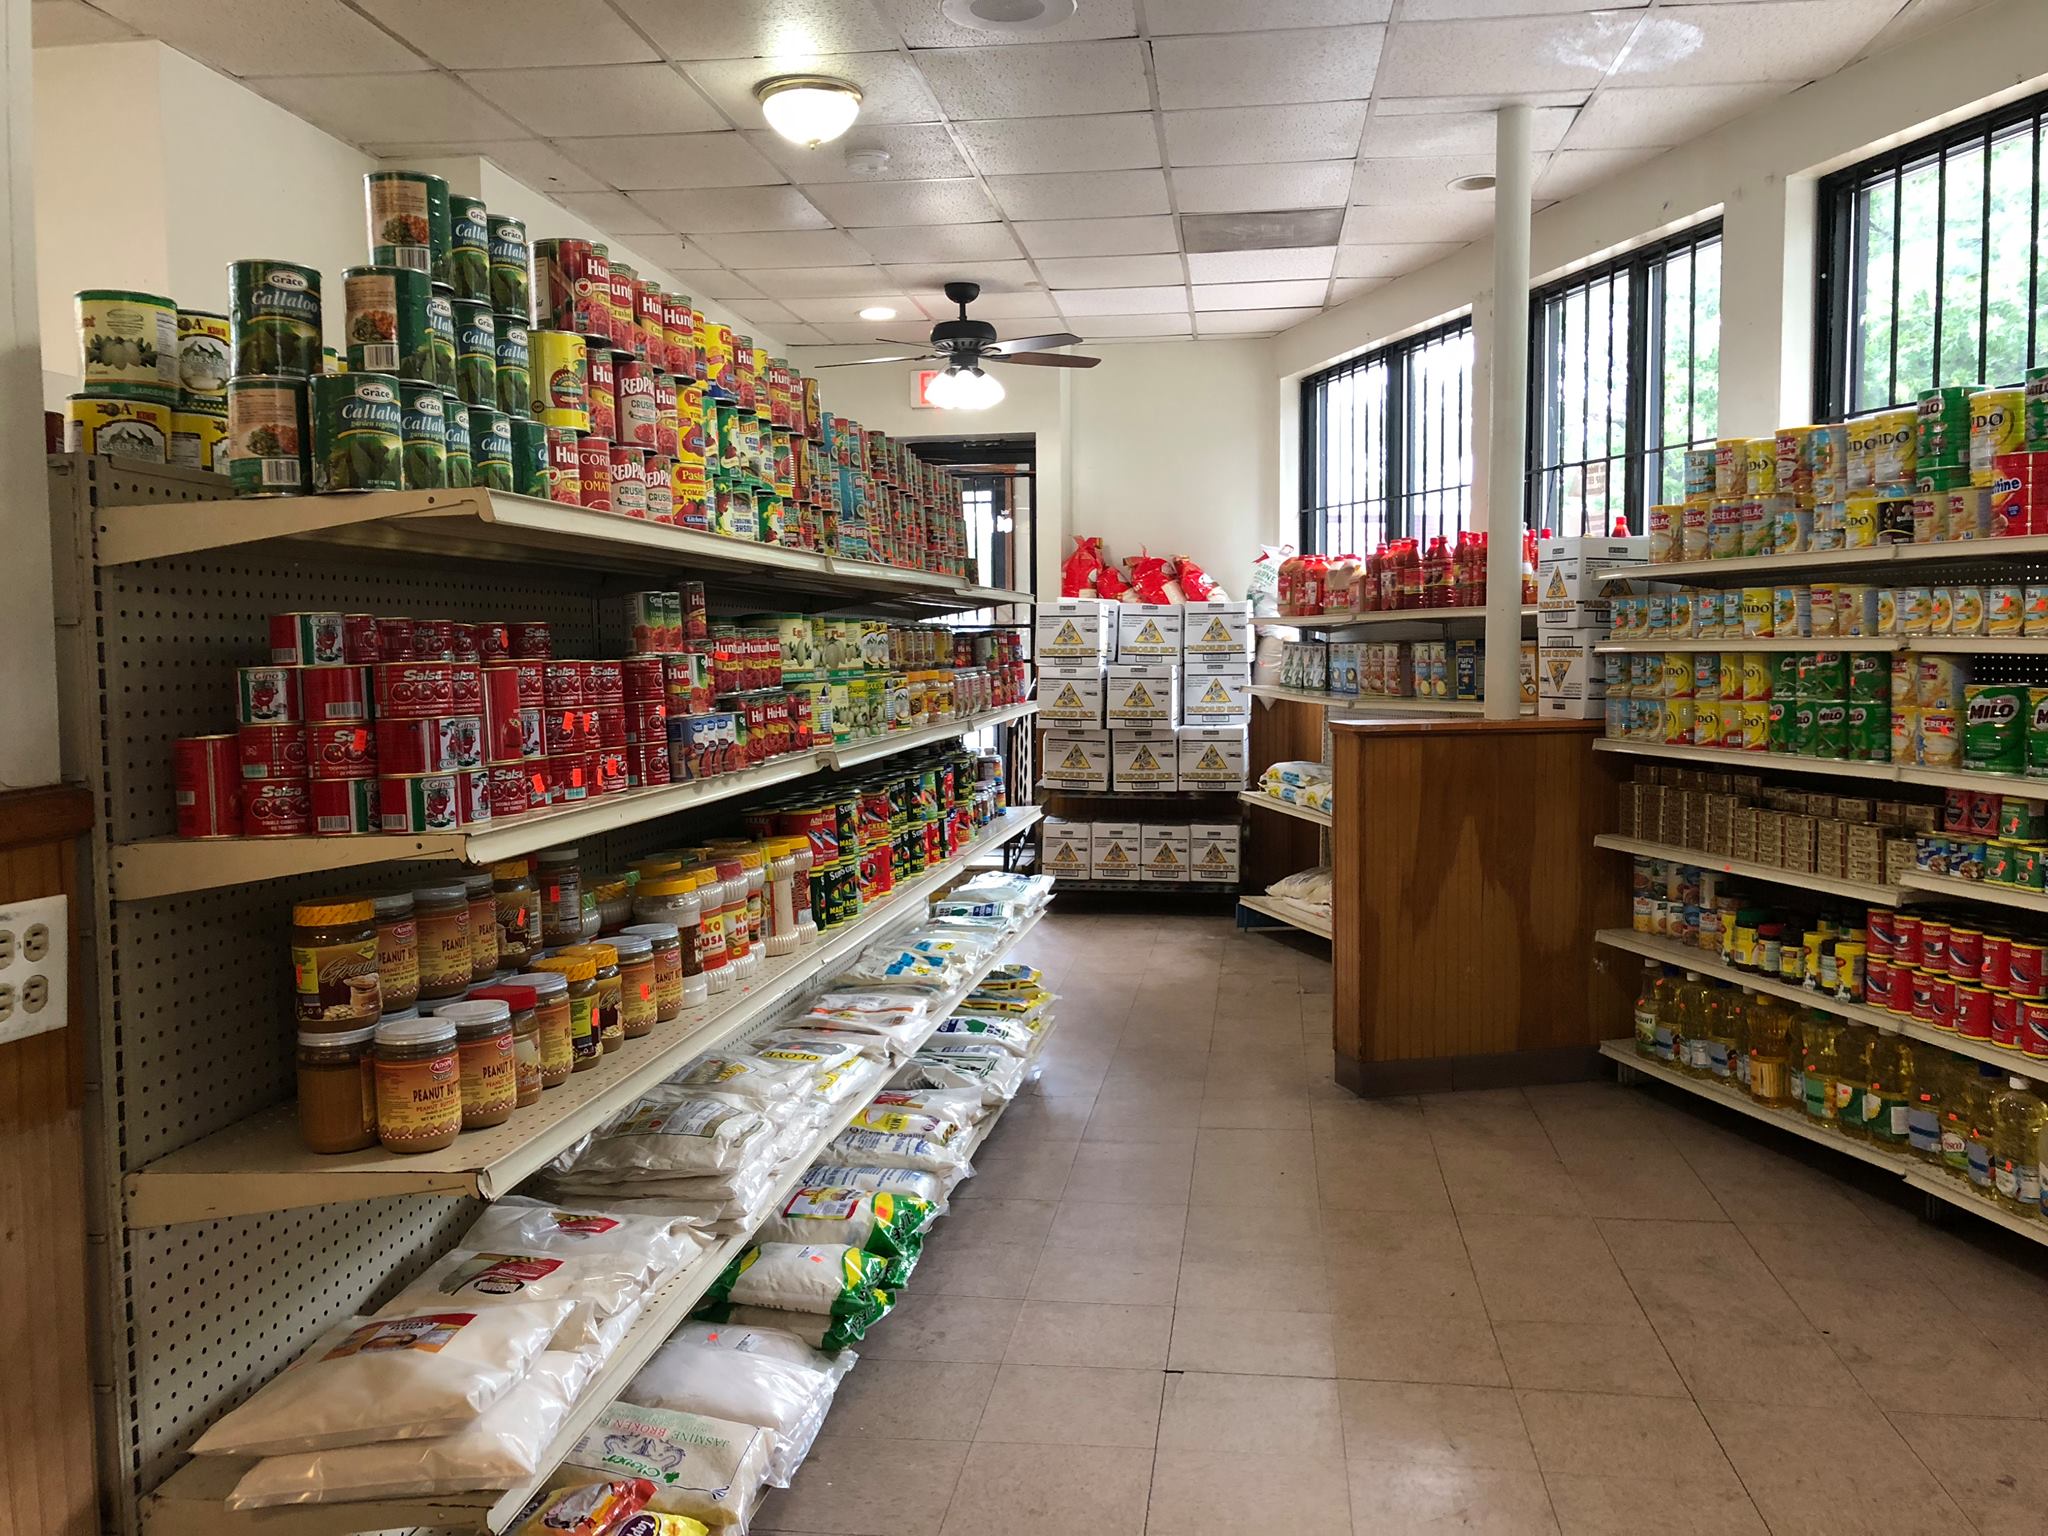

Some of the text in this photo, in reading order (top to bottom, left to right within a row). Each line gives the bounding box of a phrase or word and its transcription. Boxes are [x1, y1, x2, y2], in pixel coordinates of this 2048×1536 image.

[271, 274, 304, 287] Grace
[251, 290, 318, 313] Callaloo
[478, 318, 494, 328] Grac
[664, 308, 692, 328] Hun
[462, 331, 495, 350] Callal
[496, 344, 528, 360] Callal
[769, 370, 790, 385] Hun
[361, 387, 391, 399] Grace
[620, 376, 655, 397] REDPA
[656, 389, 676, 406] Hun
[341, 403, 401, 423] Callaloo
[402, 416, 444, 433] Callal
[556, 445, 579, 465] Hun
[594, 471, 609, 480] DICE
[579, 480, 610, 492] TOMAT
[253, 671, 279, 680] Gino
[403, 669, 442, 681] Salsa
[453, 669, 475, 681] alsa
[668, 667, 690, 681] Hun
[1819, 711, 1842, 721] MILO
[1969, 699, 2014, 719] MILO
[495, 769, 523, 781] Salsa
[261, 785, 302, 798] Salsa
[429, 780, 450, 789] Gino
[441, 936, 466, 952] PEANUT
[702, 934, 724, 947] USA
[378, 949, 407, 964] PEANUT
[482, 1061, 508, 1079] PEANUT
[413, 1086, 445, 1103] PEANUT
[616, 1418, 668, 1438] BROKEN
[672, 1430, 731, 1448] JASMINE
[602, 1453, 661, 1478] Clover
